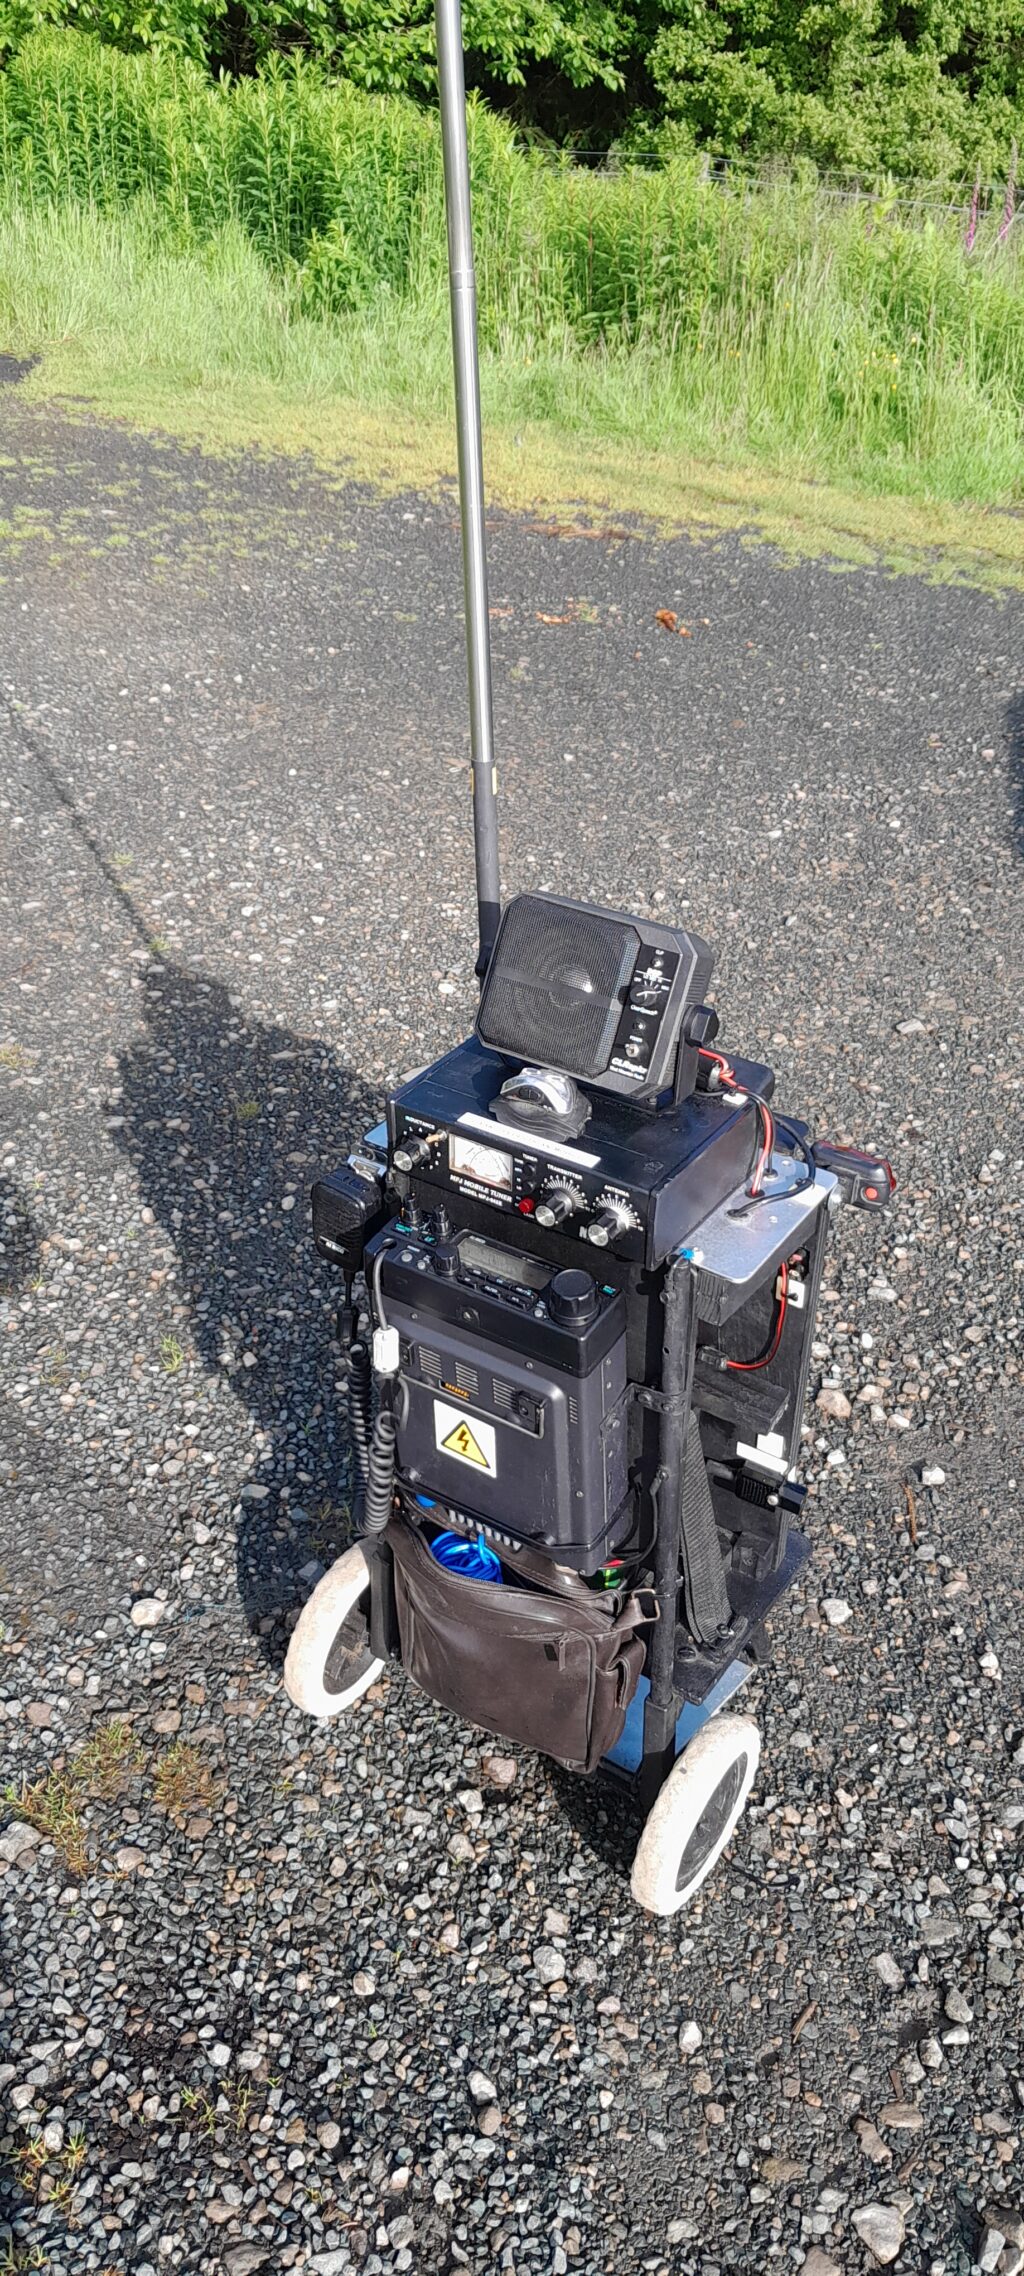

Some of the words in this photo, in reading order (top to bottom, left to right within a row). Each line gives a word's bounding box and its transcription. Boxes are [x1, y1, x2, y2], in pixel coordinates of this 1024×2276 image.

[547, 1163, 583, 1181] TRANSMITTER
[450, 1174, 463, 1184] MFJ
[464, 1179, 489, 1195] MOBILE
[490, 1189, 513, 1203] TUNER
[459, 1186, 478, 1198] MODEL
